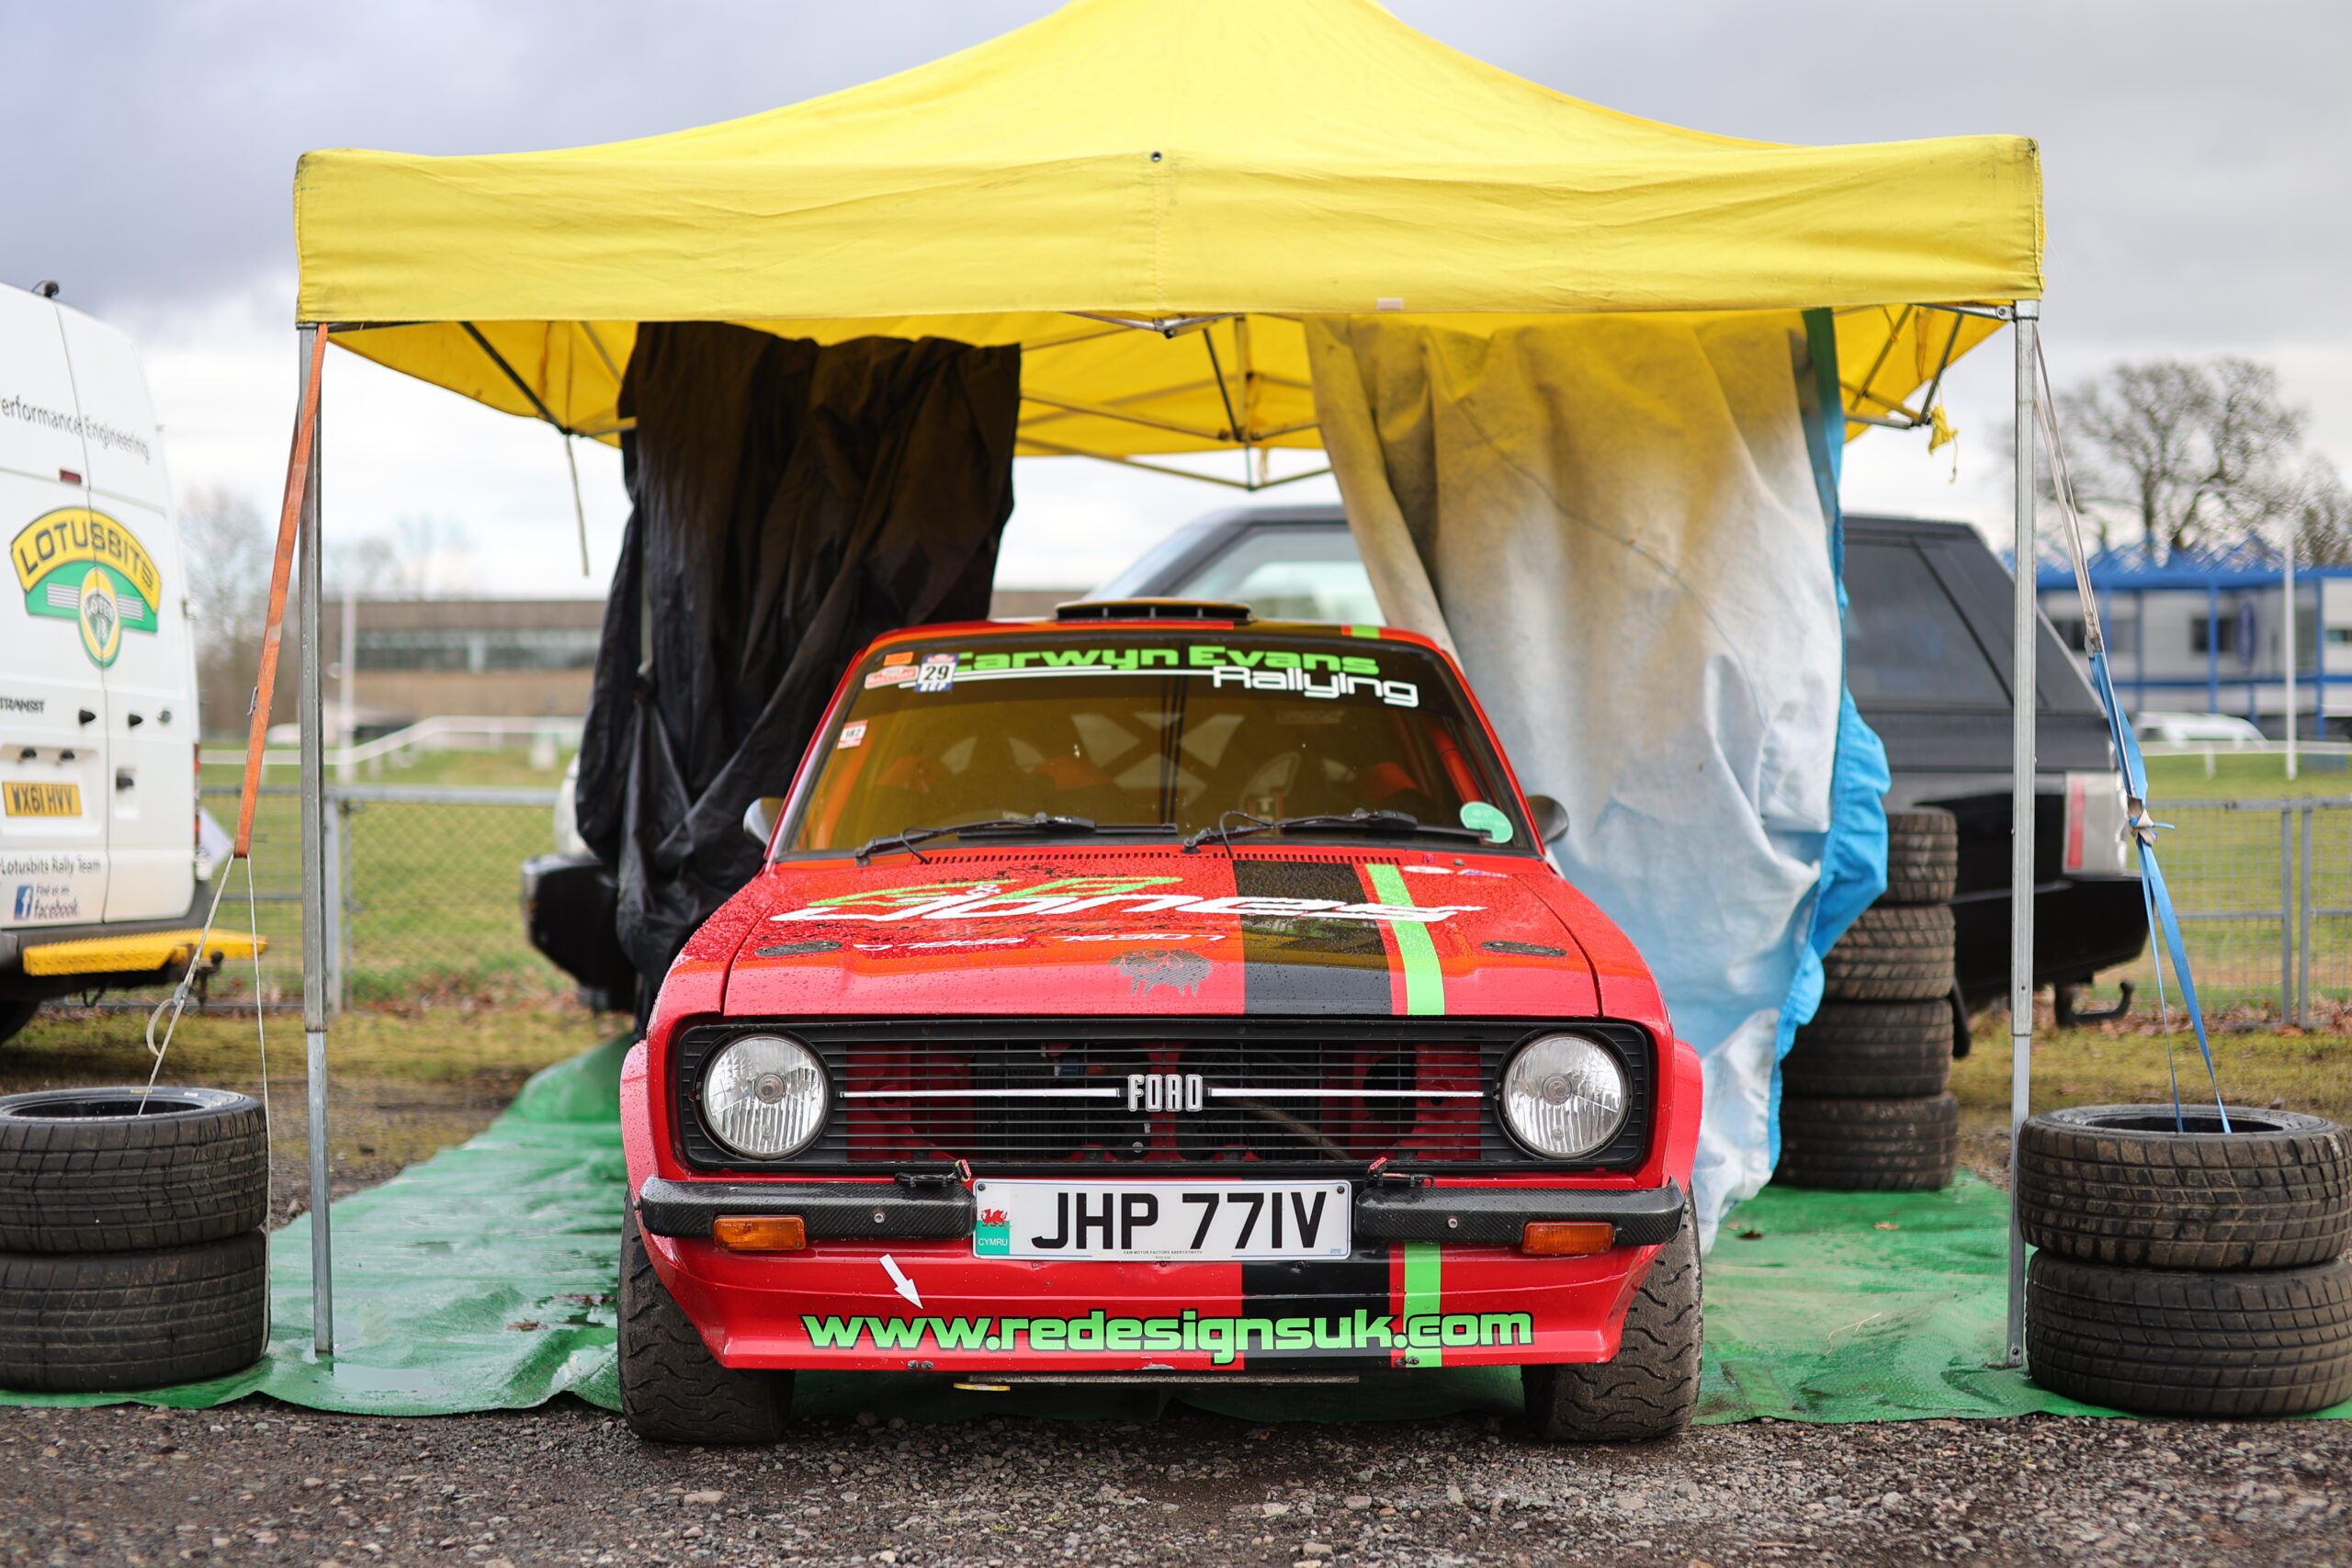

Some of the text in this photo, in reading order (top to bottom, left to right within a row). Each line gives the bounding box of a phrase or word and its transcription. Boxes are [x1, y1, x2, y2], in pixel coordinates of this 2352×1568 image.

[0, 395, 151, 464] erformance Engineering
[19, 521, 153, 590] LOTUSBITS
[923, 665, 950, 681] 29
[1189, 646, 1380, 675] Evans
[1213, 665, 1419, 707] Rallying
[51, 855, 74, 877] Rally
[769, 894, 1488, 922] Jones
[1127, 1074, 1203, 1111] FORD
[1031, 1193, 1159, 1250] JHP
[978, 1237, 1008, 1247] CYMRU
[801, 1306, 1535, 1365] www.redesignsuk.com
